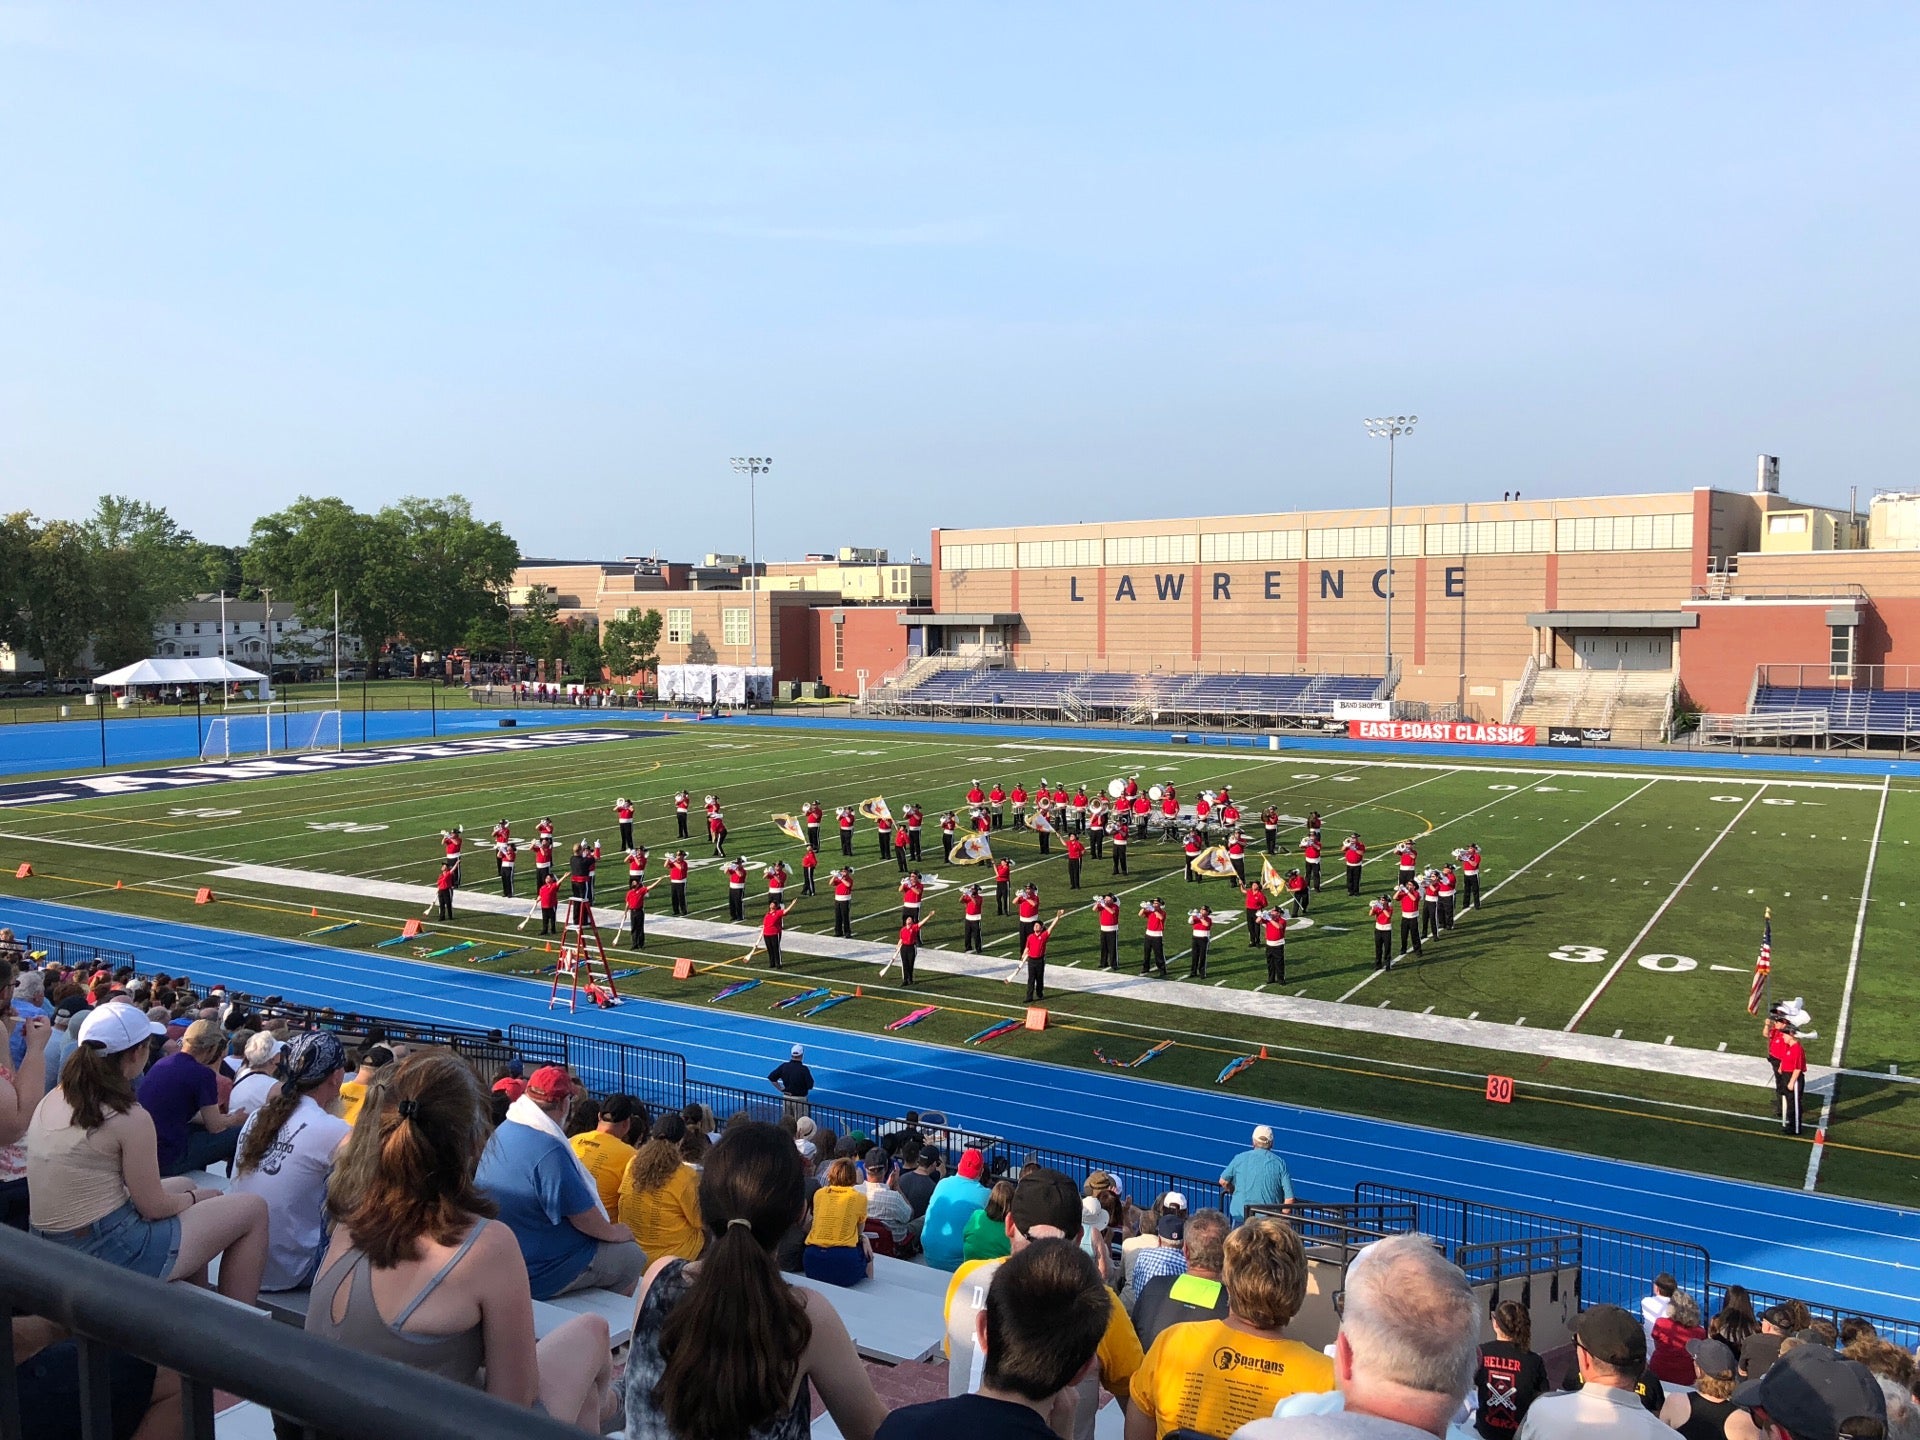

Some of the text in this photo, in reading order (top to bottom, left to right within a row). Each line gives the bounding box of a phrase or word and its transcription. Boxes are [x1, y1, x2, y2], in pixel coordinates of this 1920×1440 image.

[1070, 566, 1466, 602] LAWRENCE
[1340, 701, 1358, 709] BAND
[1360, 721, 1397, 738] EAST
[1401, 723, 1451, 740] COAST
[1455, 725, 1525, 743] CLASSIC
[1548, 945, 1698, 972] 30
[1489, 1077, 1510, 1100] 30
[1233, 1352, 1285, 1373] Spartans
[1483, 1355, 1521, 1372] HELLER
